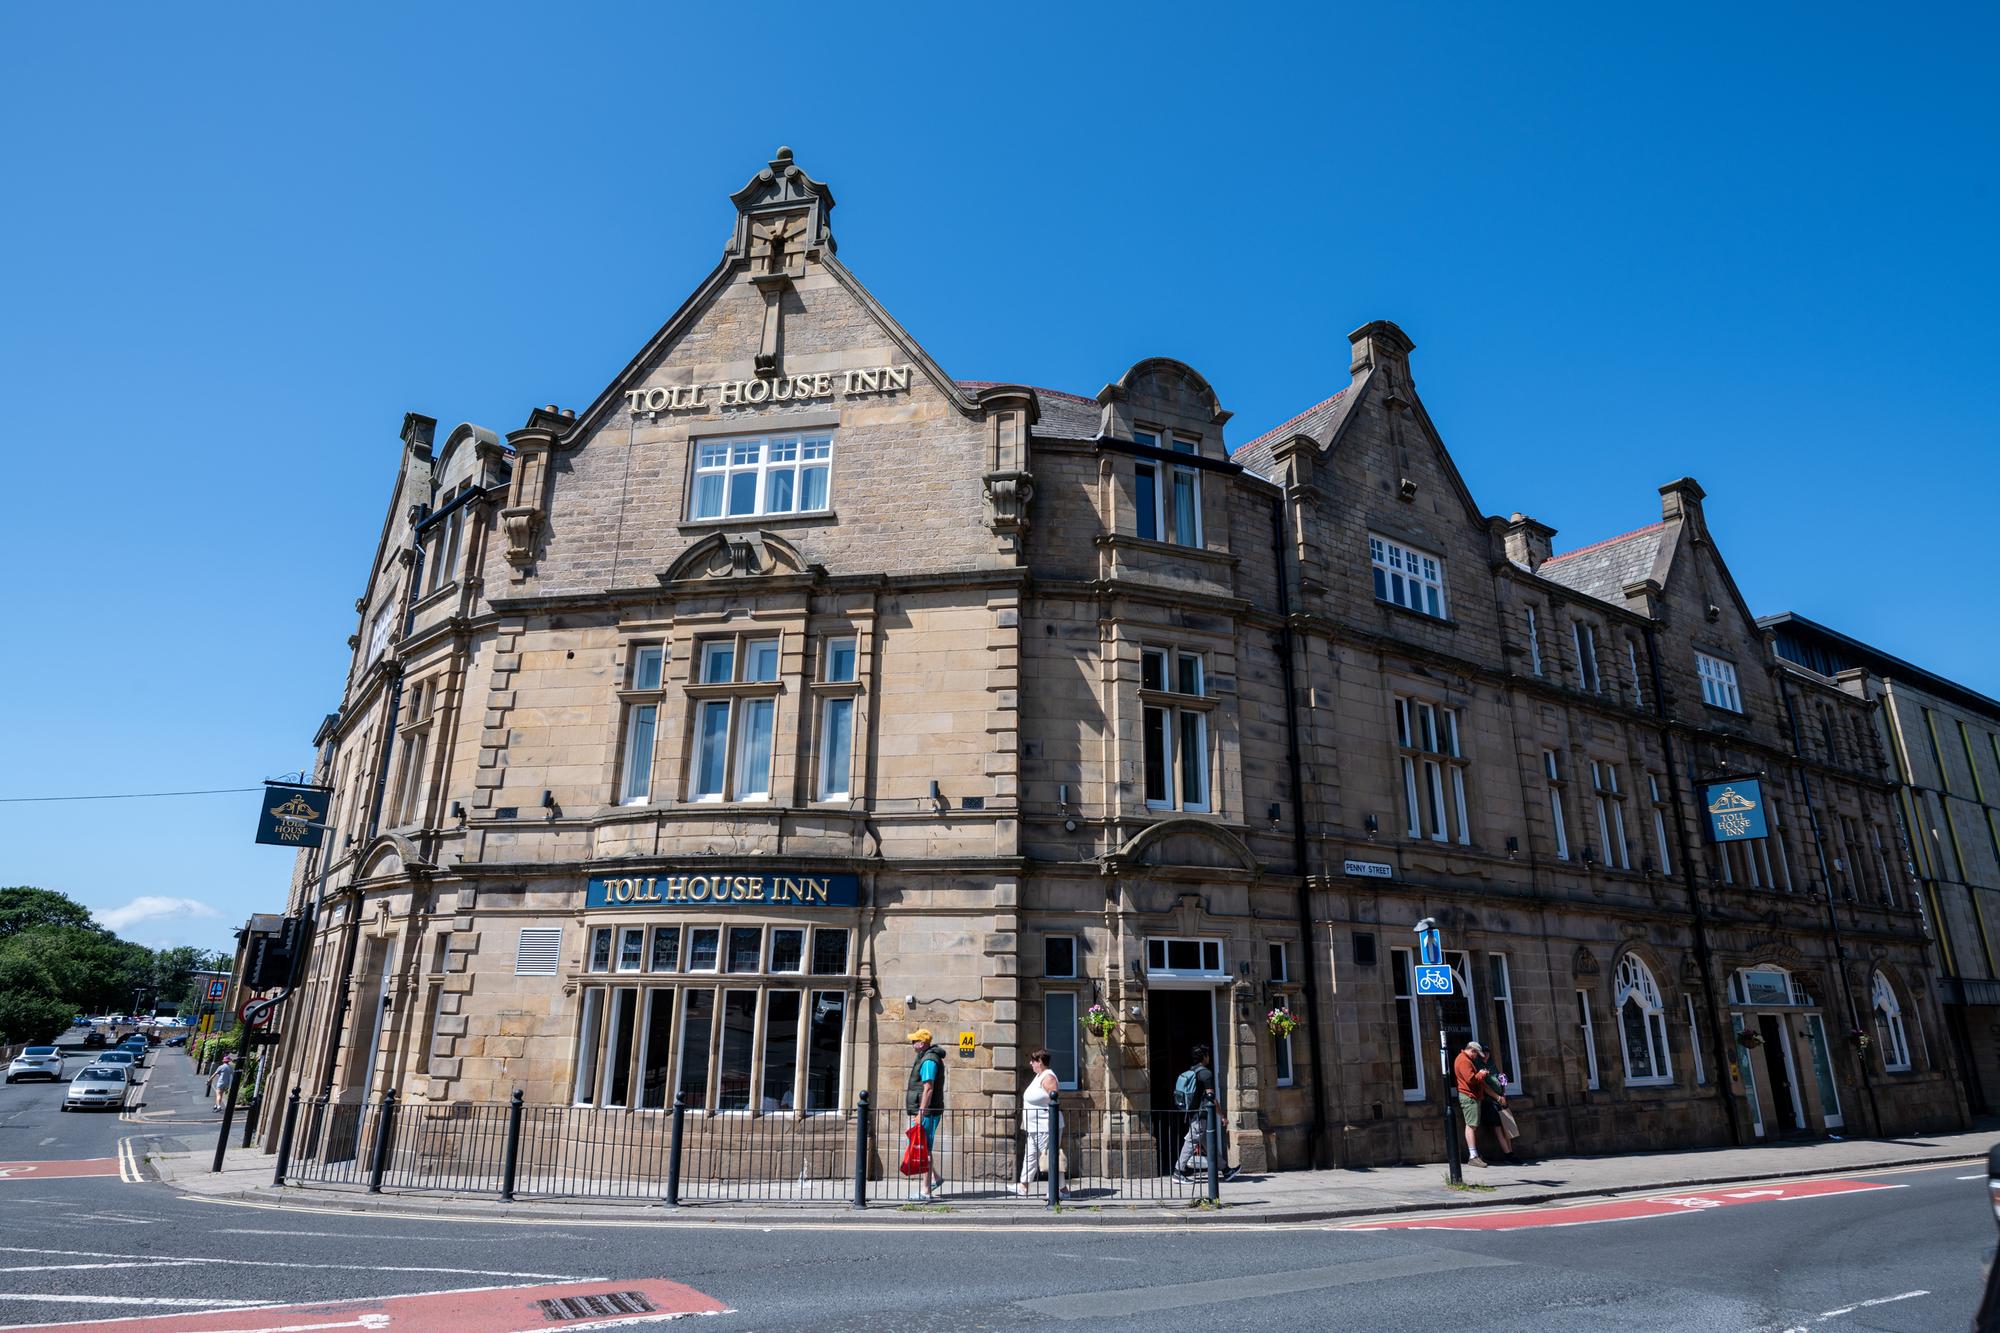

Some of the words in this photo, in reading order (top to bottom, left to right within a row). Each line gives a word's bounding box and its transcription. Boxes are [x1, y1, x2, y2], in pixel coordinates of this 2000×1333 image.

[625, 384, 708, 414] TOLL
[719, 372, 833, 405] HOUSE
[843, 365, 909, 395] INN
[1720, 812, 1745, 822] TOLL
[1718, 819, 1751, 830] HOUSE
[274, 825, 309, 835] HOUSE
[1726, 827, 1745, 836] INN
[280, 833, 300, 841] INN
[1346, 863, 1366, 873] PENNY
[1368, 865, 1390, 875] STREET
[603, 877, 661, 902] TOLL
[666, 876, 764, 901] HOUSE
[771, 877, 830, 901] INN
[962, 1036, 973, 1046] AA
